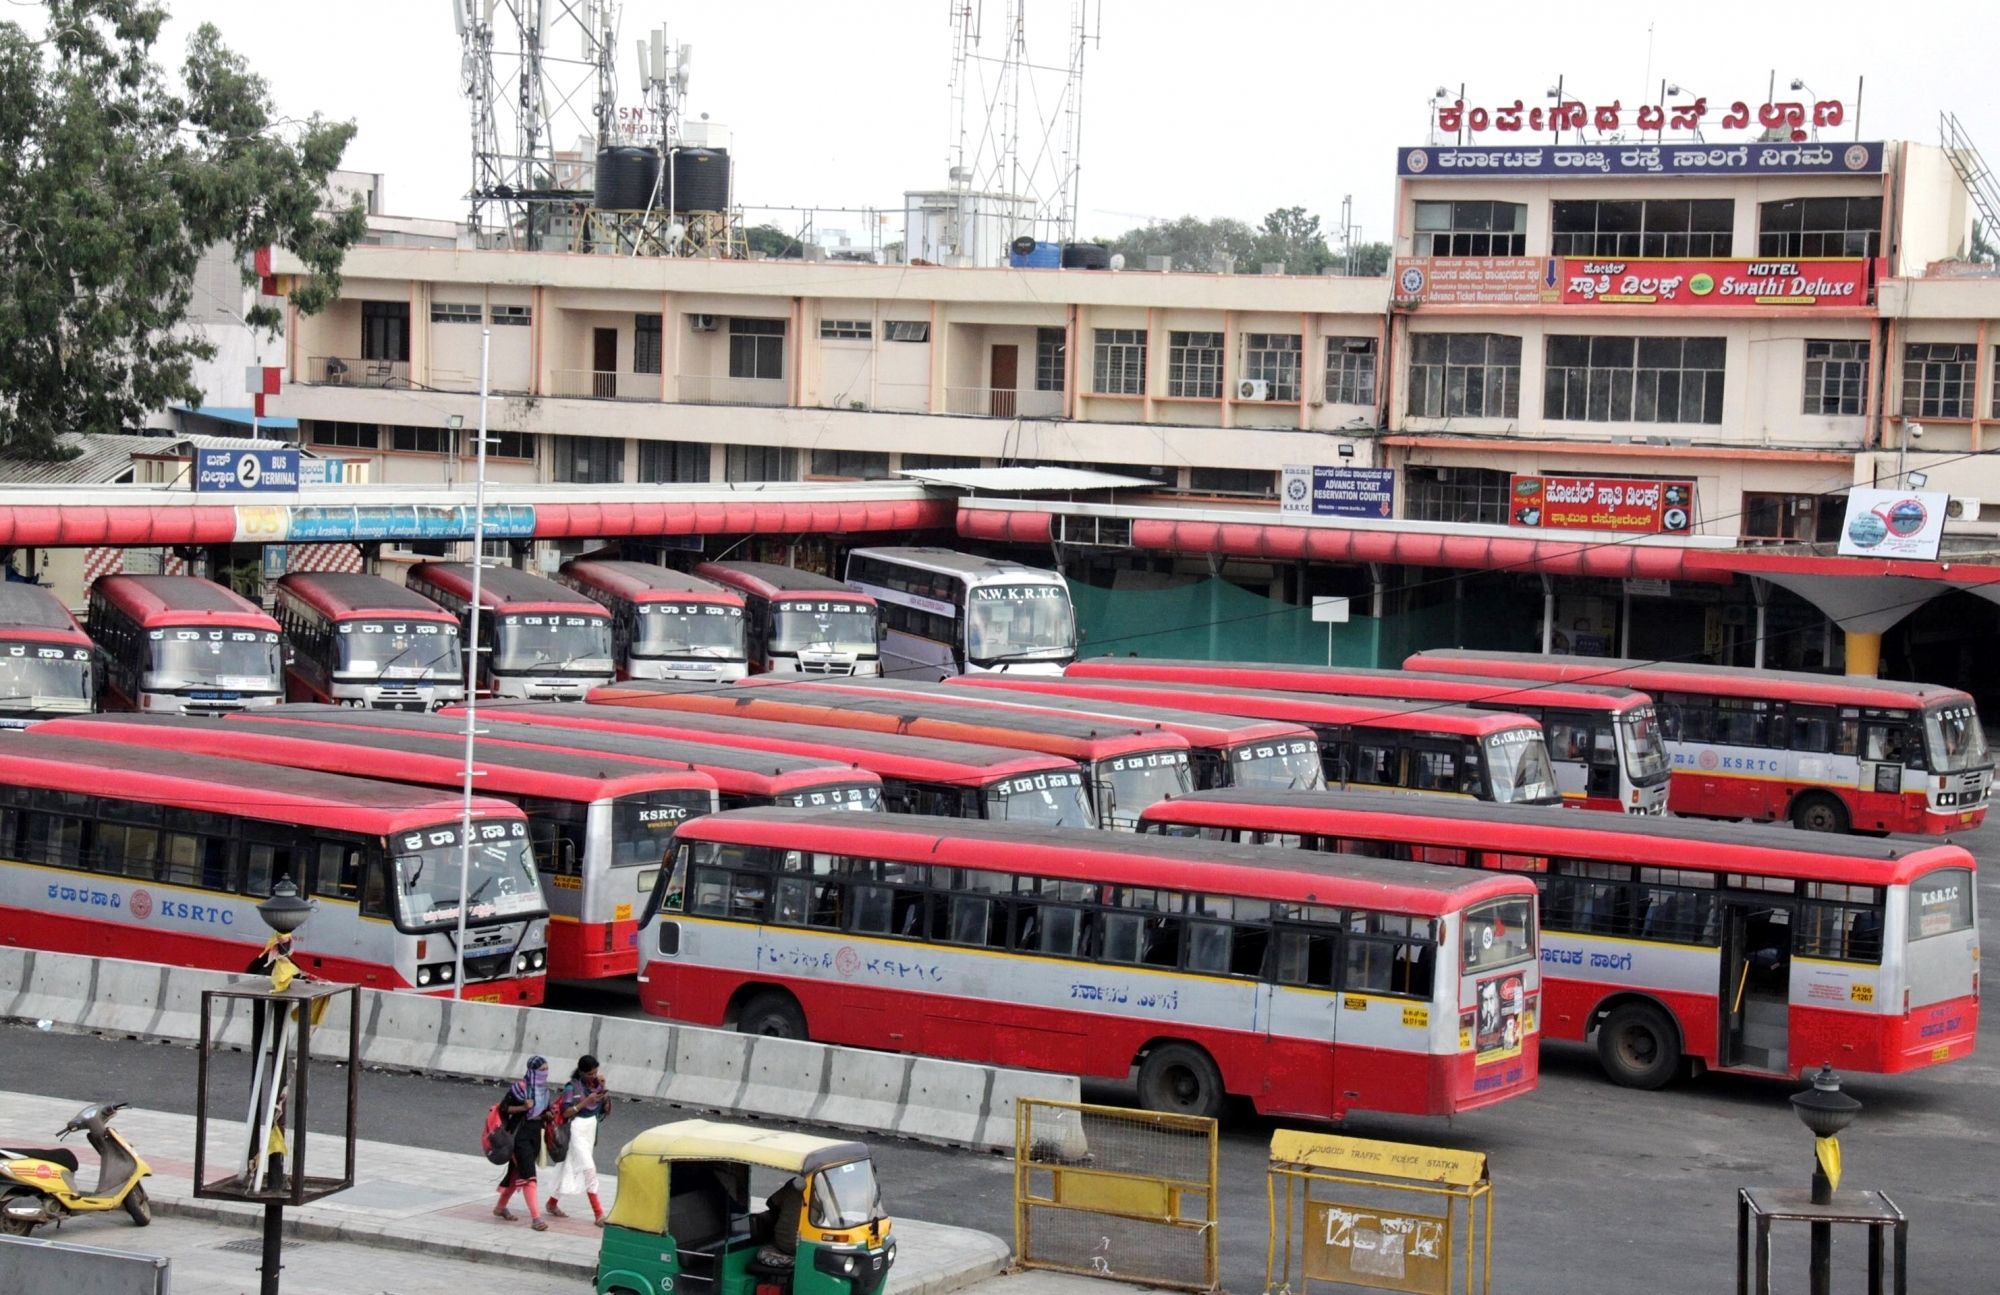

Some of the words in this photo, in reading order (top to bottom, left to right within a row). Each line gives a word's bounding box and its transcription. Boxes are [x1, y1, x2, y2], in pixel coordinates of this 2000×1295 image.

[1439, 100, 1621, 136] ಕೆಂಪೇಗೌಡ
[1636, 97, 1708, 131] ಬಸ್
[1722, 99, 1844, 143] ನಿಲ್ದಾಣ
[1438, 149, 1543, 168] ಕರ್ನಾಟಕ
[1553, 150, 1611, 172] ರಾಜ್ಯ
[1620, 147, 1664, 171] ರಸ್ತೆ
[1673, 146, 1749, 168] ಸಾರಿಗೆ
[1759, 146, 1833, 166] ನಿಗಮ
[1583, 262, 1625, 274] ಹೋಟೆಲ್
[1747, 263, 1799, 275] HOTEL
[1567, 274, 1610, 299] ಸ್ವಾತಿ
[1620, 275, 1683, 299] ಡಿಲಕ್ಸ್
[1720, 276, 1785, 295] Swathi
[1790, 277, 1855, 295] Deluxe
[1430, 292, 1455, 301] Advance
[1456, 292, 1475, 301] Ticket
[1477, 292, 1513, 301] Reservation
[1515, 292, 1539, 301] Counter
[206, 452, 231, 466] ಬಸ್
[272, 456, 286, 470] BUS
[243, 459, 254, 481] 2
[201, 469, 236, 488] ನಿಲ್ದಾಣ
[261, 471, 296, 486] TERMINAL
[1324, 479, 1355, 490] ADVANCE
[1356, 481, 1381, 491] TICKET
[1314, 490, 1358, 501] RESERVATION
[1359, 492, 1391, 502] COUNTER
[1546, 480, 1595, 504] ಹೋಟೆಲ್
[1598, 485, 1623, 512] ಸ್ವಾತಿ
[1626, 484, 1659, 511] ಡಿಲಕ್ಸ್
[977, 586, 1060, 600] N.W.K.R.T.C
[1723, 757, 1778, 772] KSRTC
[639, 808, 688, 821] KSRTC
[161, 900, 234, 926] KSRTC
[1540, 947, 1584, 965] ರ್ನಾಟಕ
[1590, 951, 1632, 970] ಸಾರಿಗೆ
[1351, 1149, 1383, 1161] TRAFFIC
[1391, 1155, 1420, 1165] POLICE
[1426, 1159, 1459, 1169] STATION
